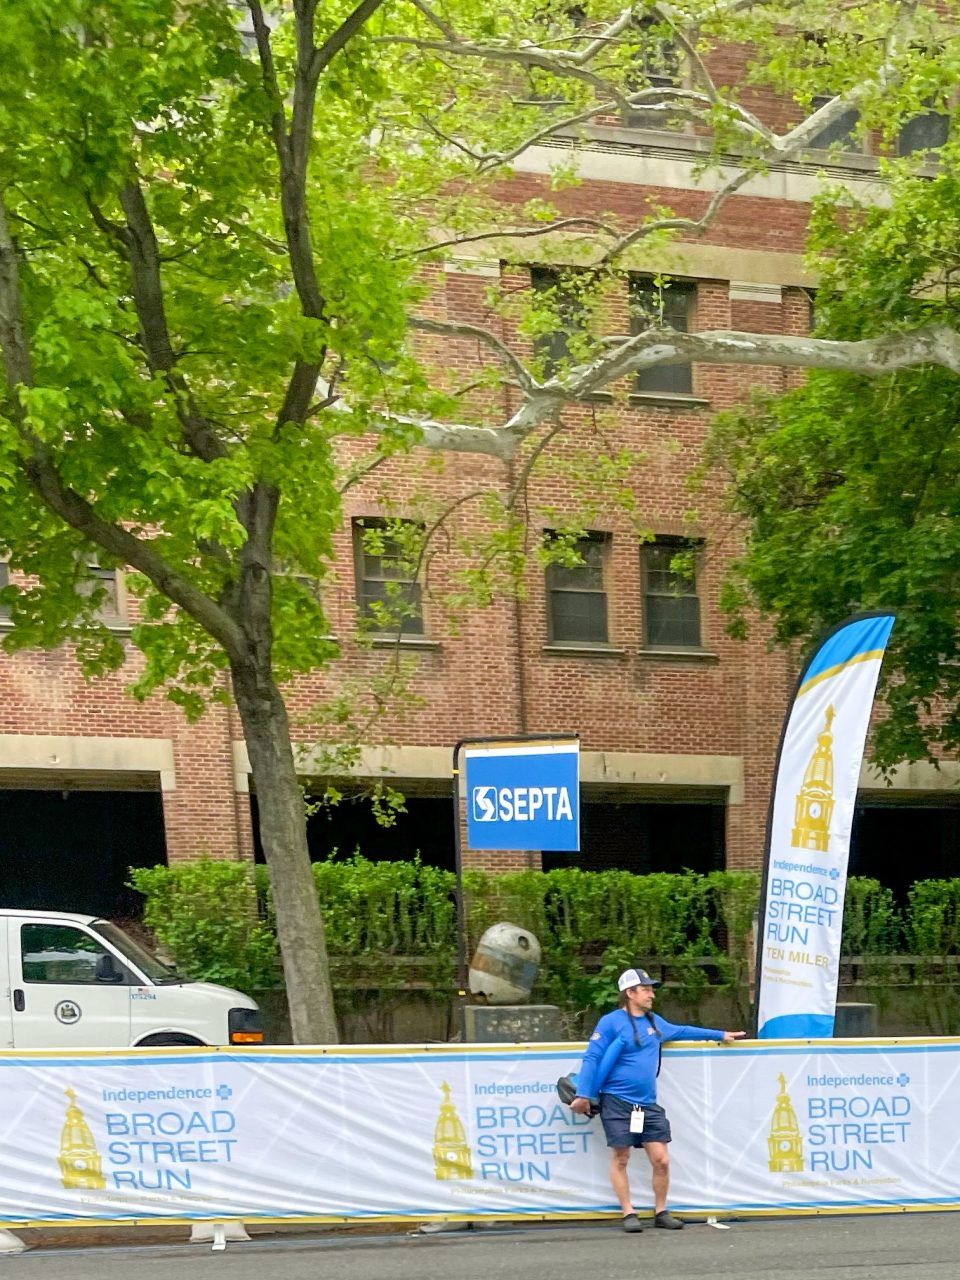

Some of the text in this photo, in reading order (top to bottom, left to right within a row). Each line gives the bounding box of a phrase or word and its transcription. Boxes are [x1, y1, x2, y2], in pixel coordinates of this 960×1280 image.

[499, 787, 573, 821] SEPTA
[773, 860, 828, 876] Independence
[771, 878, 838, 905] BROAD
[768, 900, 837, 927] STREET
[767, 922, 809, 945] RUN
[766, 947, 829, 968] TEN MILER
[474, 1082, 557, 1097] Independen
[807, 1073, 894, 1088] Independence
[102, 1086, 213, 1103] Independence
[808, 1096, 912, 1118] BROAD
[105, 1110, 236, 1136] BROAD
[808, 1122, 912, 1146] STREET
[108, 1139, 238, 1165] STREET
[477, 1131, 594, 1157] STREET
[481, 1161, 551, 1182] RUN
[810, 1149, 873, 1172] RUN
[112, 1168, 192, 1190] RUN
